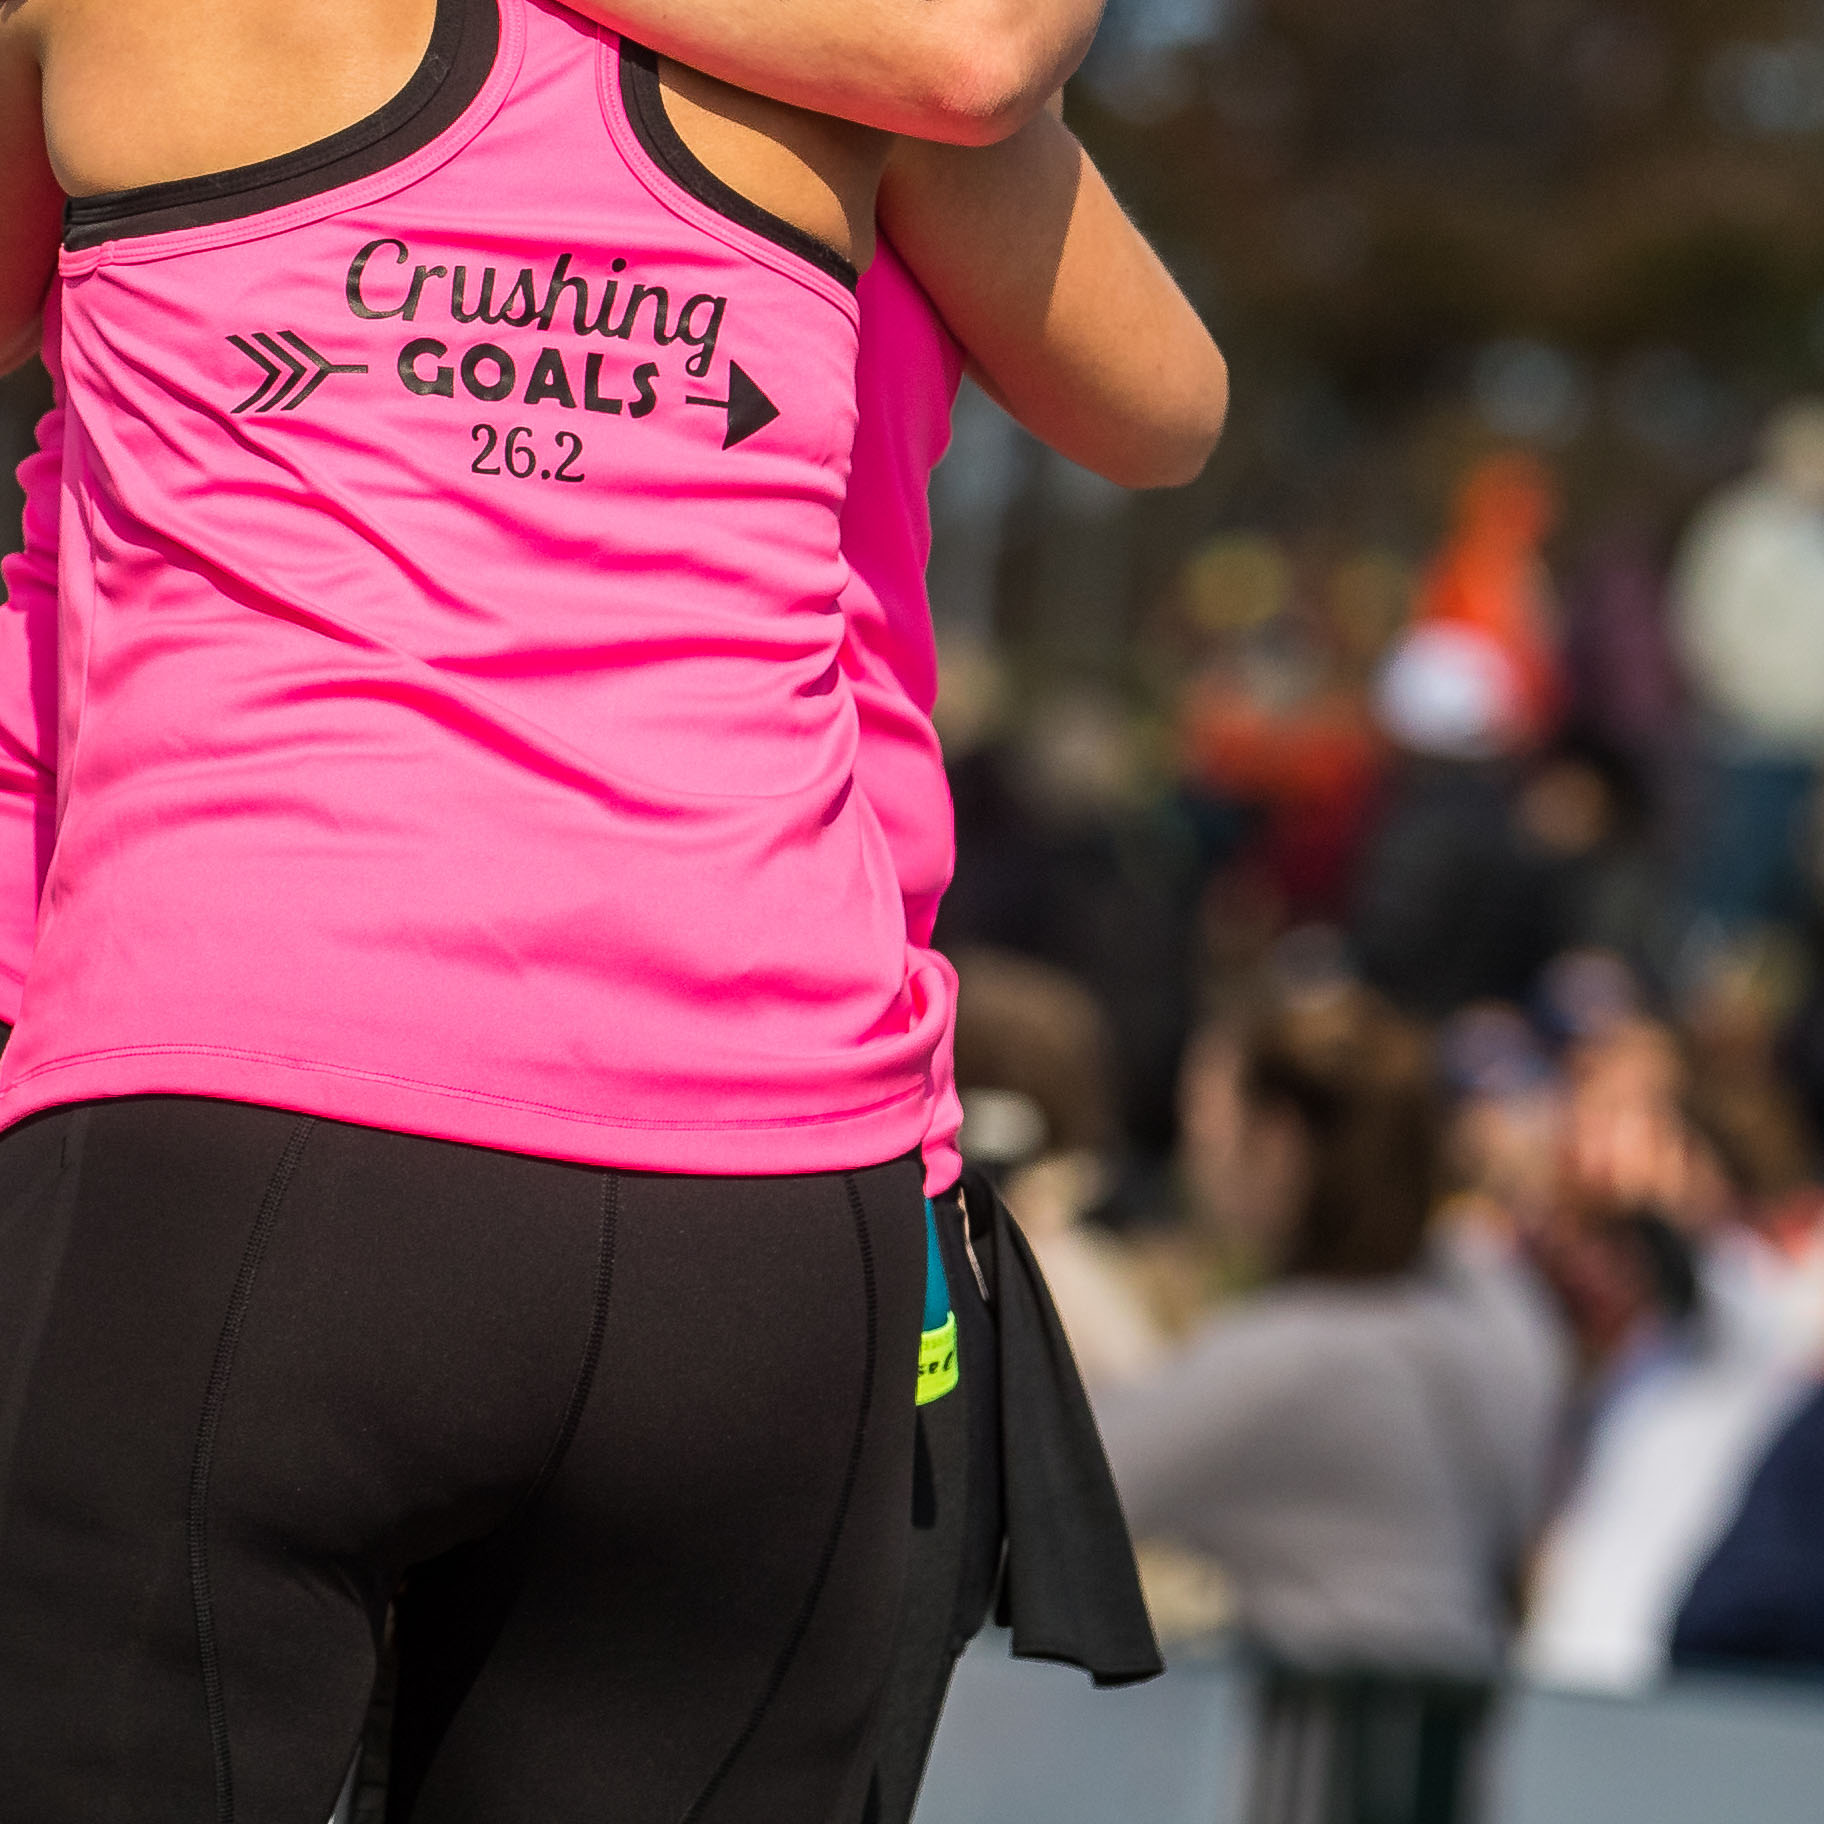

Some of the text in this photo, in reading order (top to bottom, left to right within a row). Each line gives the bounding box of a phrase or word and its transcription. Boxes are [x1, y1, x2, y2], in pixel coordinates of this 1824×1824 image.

[345, 238, 727, 377] Crushing
[397, 337, 660, 417] GOALS
[471, 424, 585, 482] 26.2
